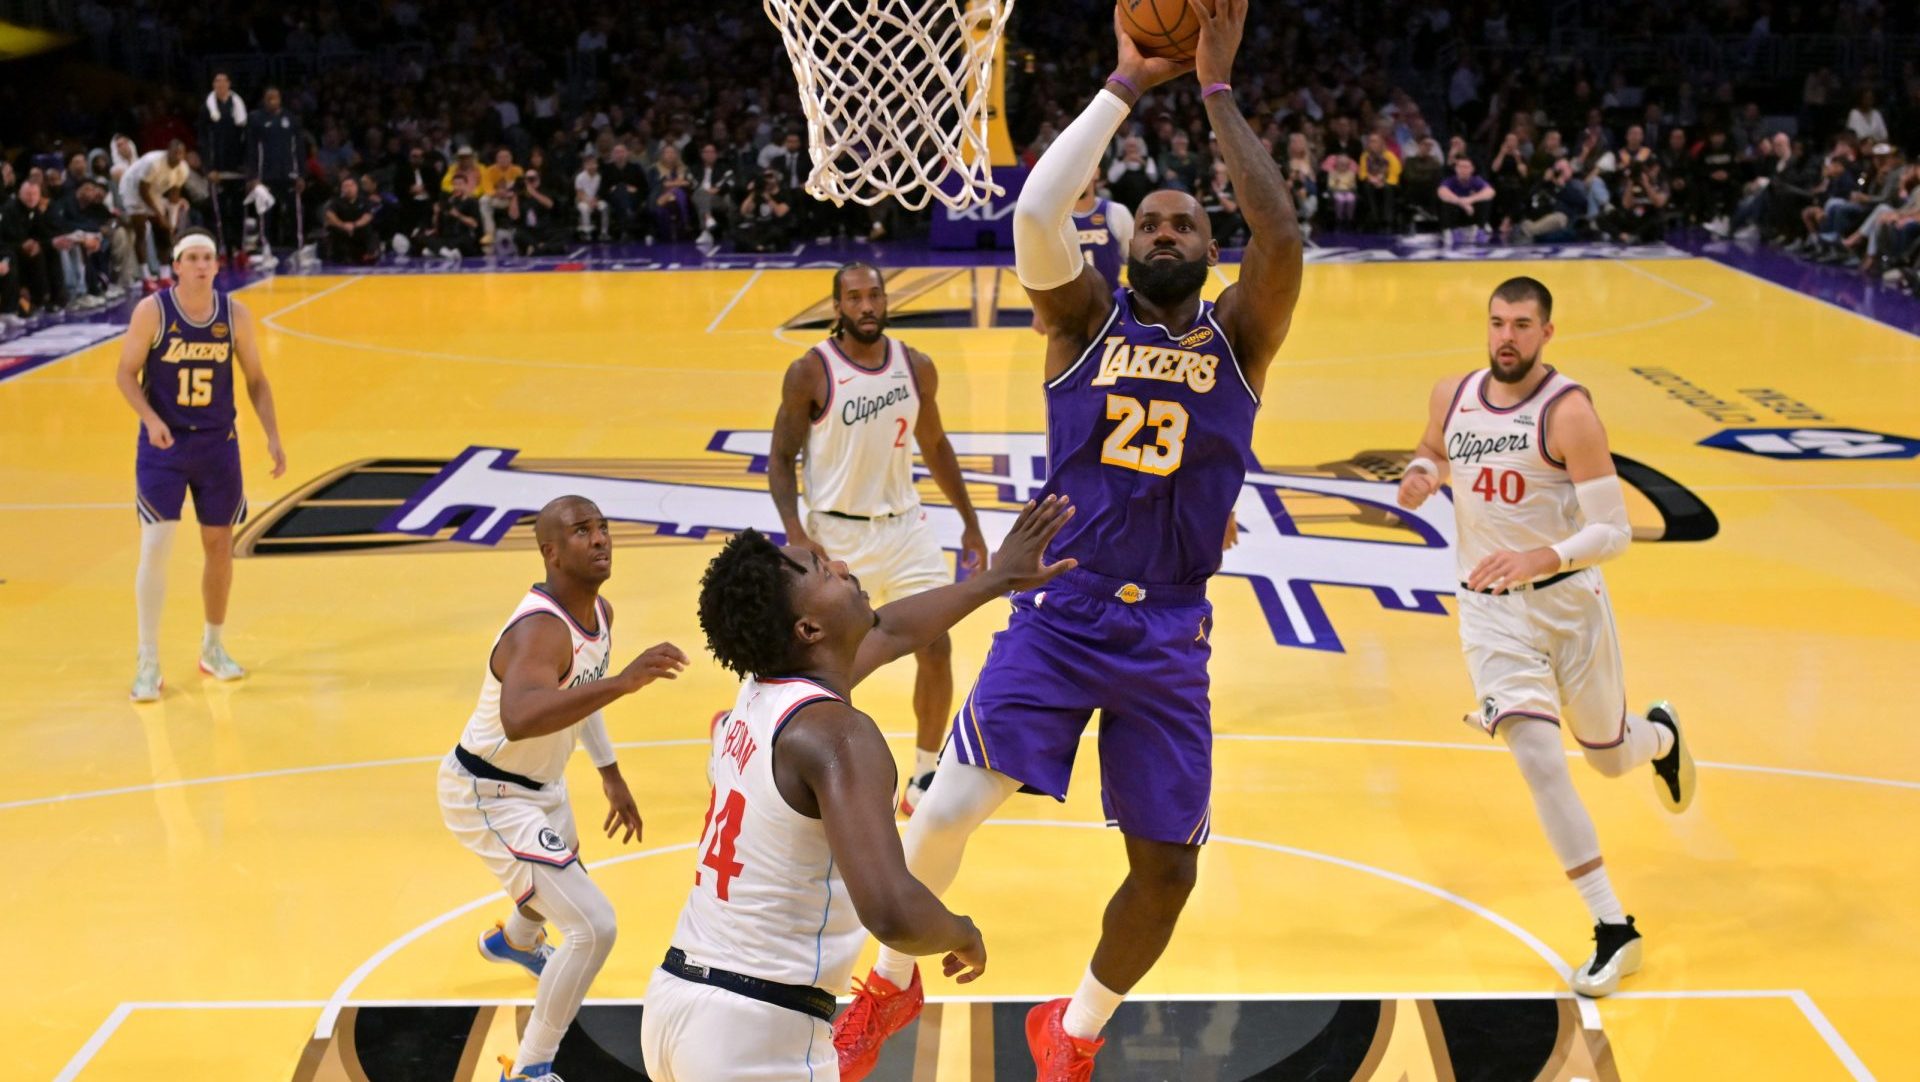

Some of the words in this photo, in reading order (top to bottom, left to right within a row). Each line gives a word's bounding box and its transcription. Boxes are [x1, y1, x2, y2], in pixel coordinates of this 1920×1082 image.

[161, 337, 230, 364] LAKERS
[1090, 336, 1220, 394] LAKERS
[177, 368, 214, 407] 15
[842, 385, 910, 426] Clippers
[894, 416, 908, 448] 2
[1100, 393, 1190, 477] 23
[1448, 431, 1530, 464] Clippers
[1472, 466, 1526, 505] 40
